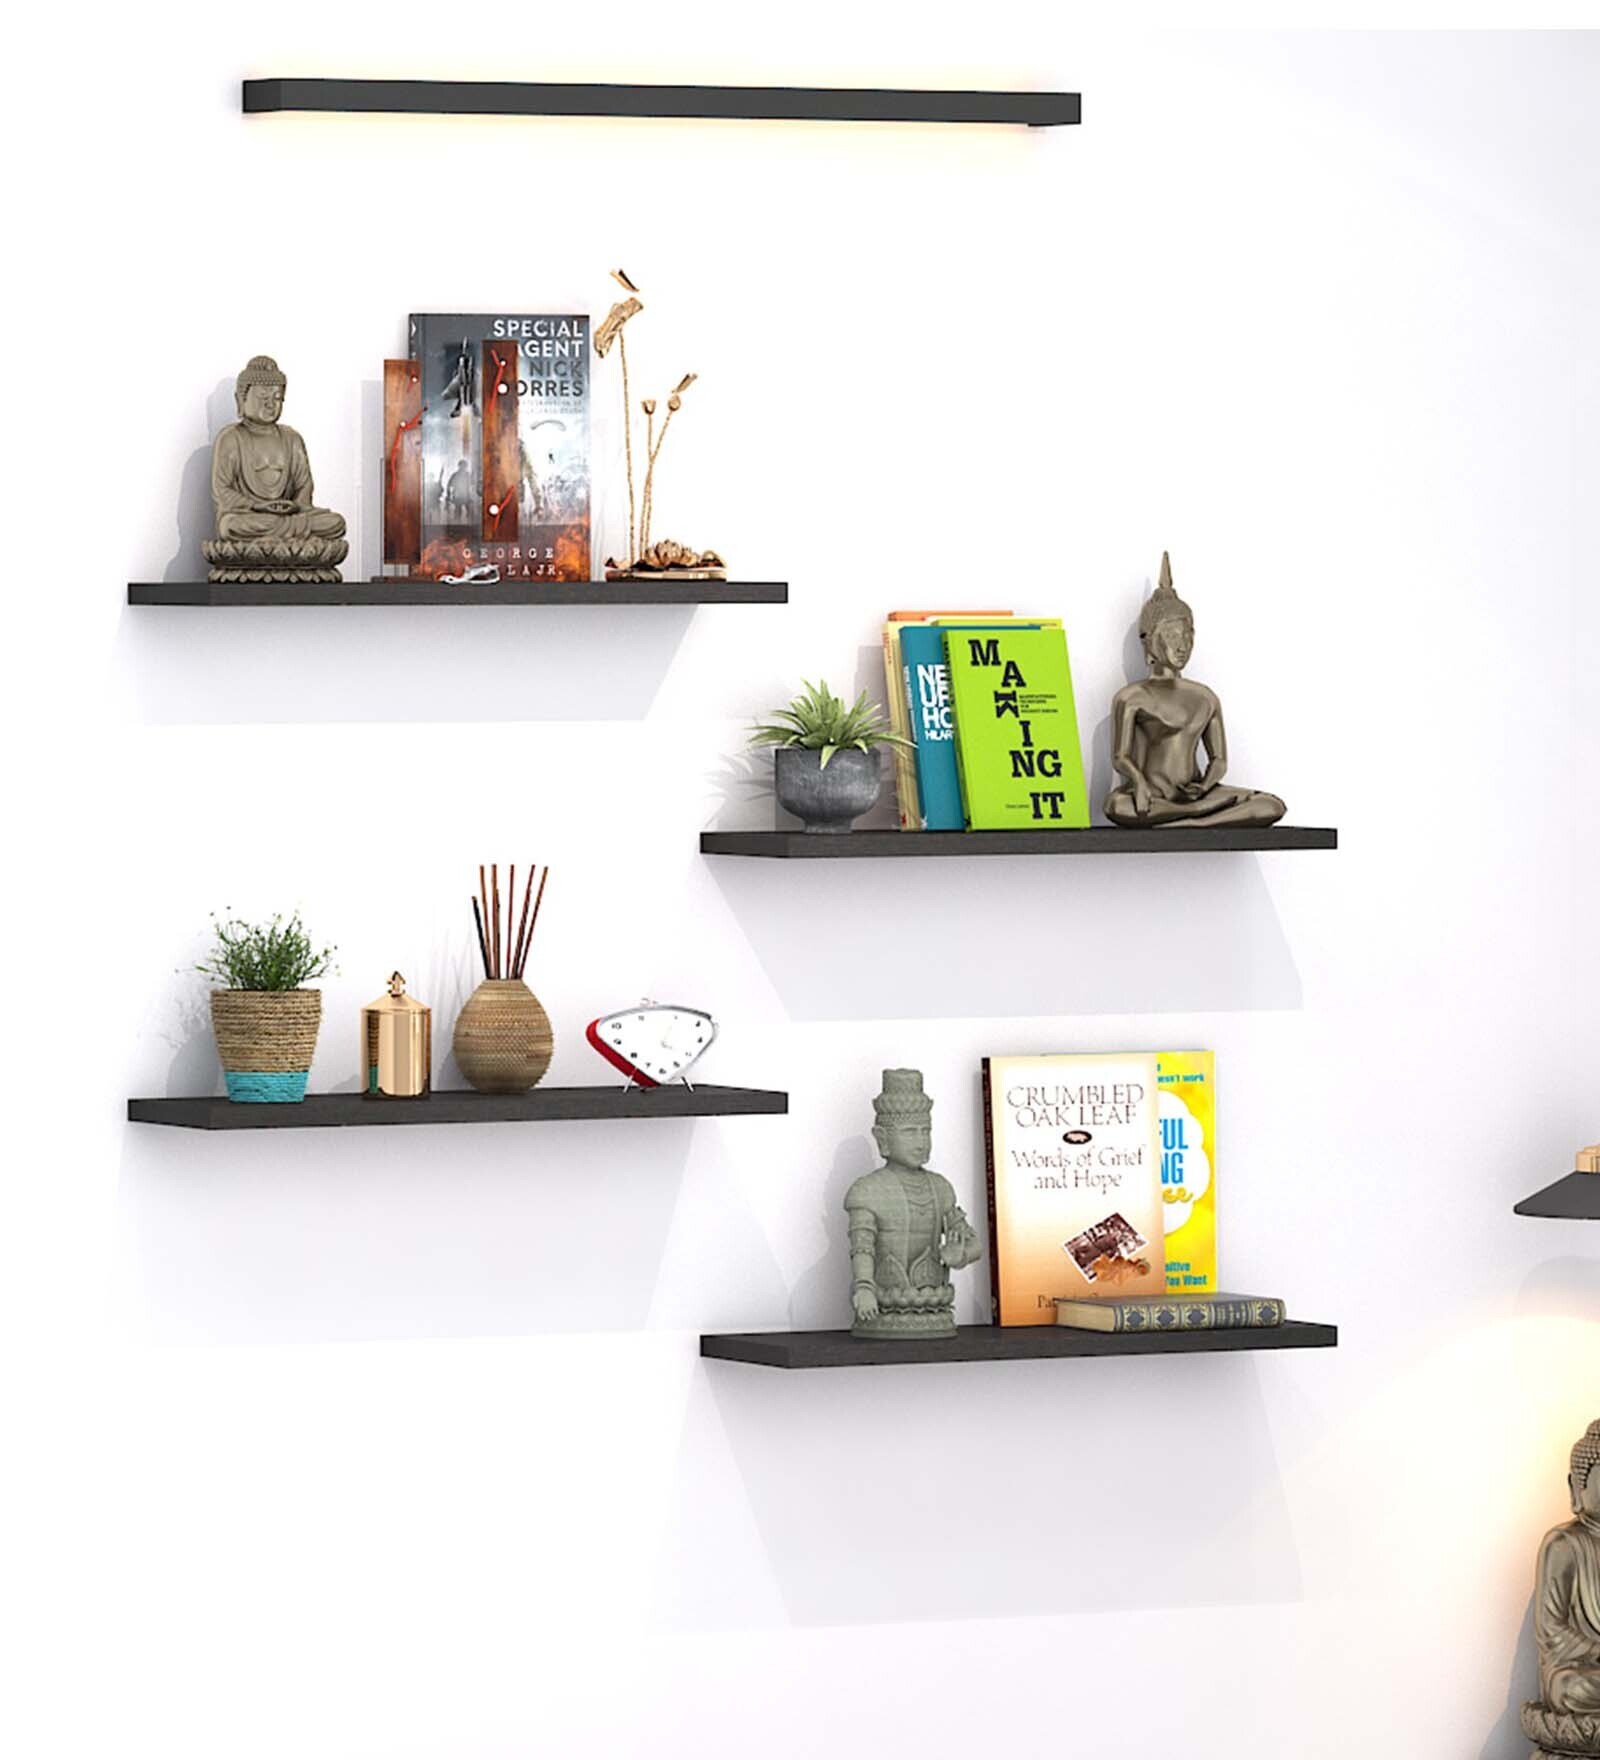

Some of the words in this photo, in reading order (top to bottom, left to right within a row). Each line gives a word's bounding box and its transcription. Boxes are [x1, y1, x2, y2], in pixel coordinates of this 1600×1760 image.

[494, 320, 584, 337] SPECIAL
[529, 361, 583, 378] NICK
[518, 380, 584, 397] ORRES
[1029, 792, 1065, 819] IT
[1006, 1083, 1145, 1107] CRUMBLED
[1016, 1106, 1072, 1128] OAK
[1079, 1105, 1137, 1125] LEAF
[1159, 1118, 1189, 1149] UL
[1011, 1147, 1072, 1168] Words
[1076, 1145, 1096, 1167] of
[1034, 1168, 1068, 1189] and
[1074, 1169, 1123, 1195] Hope
